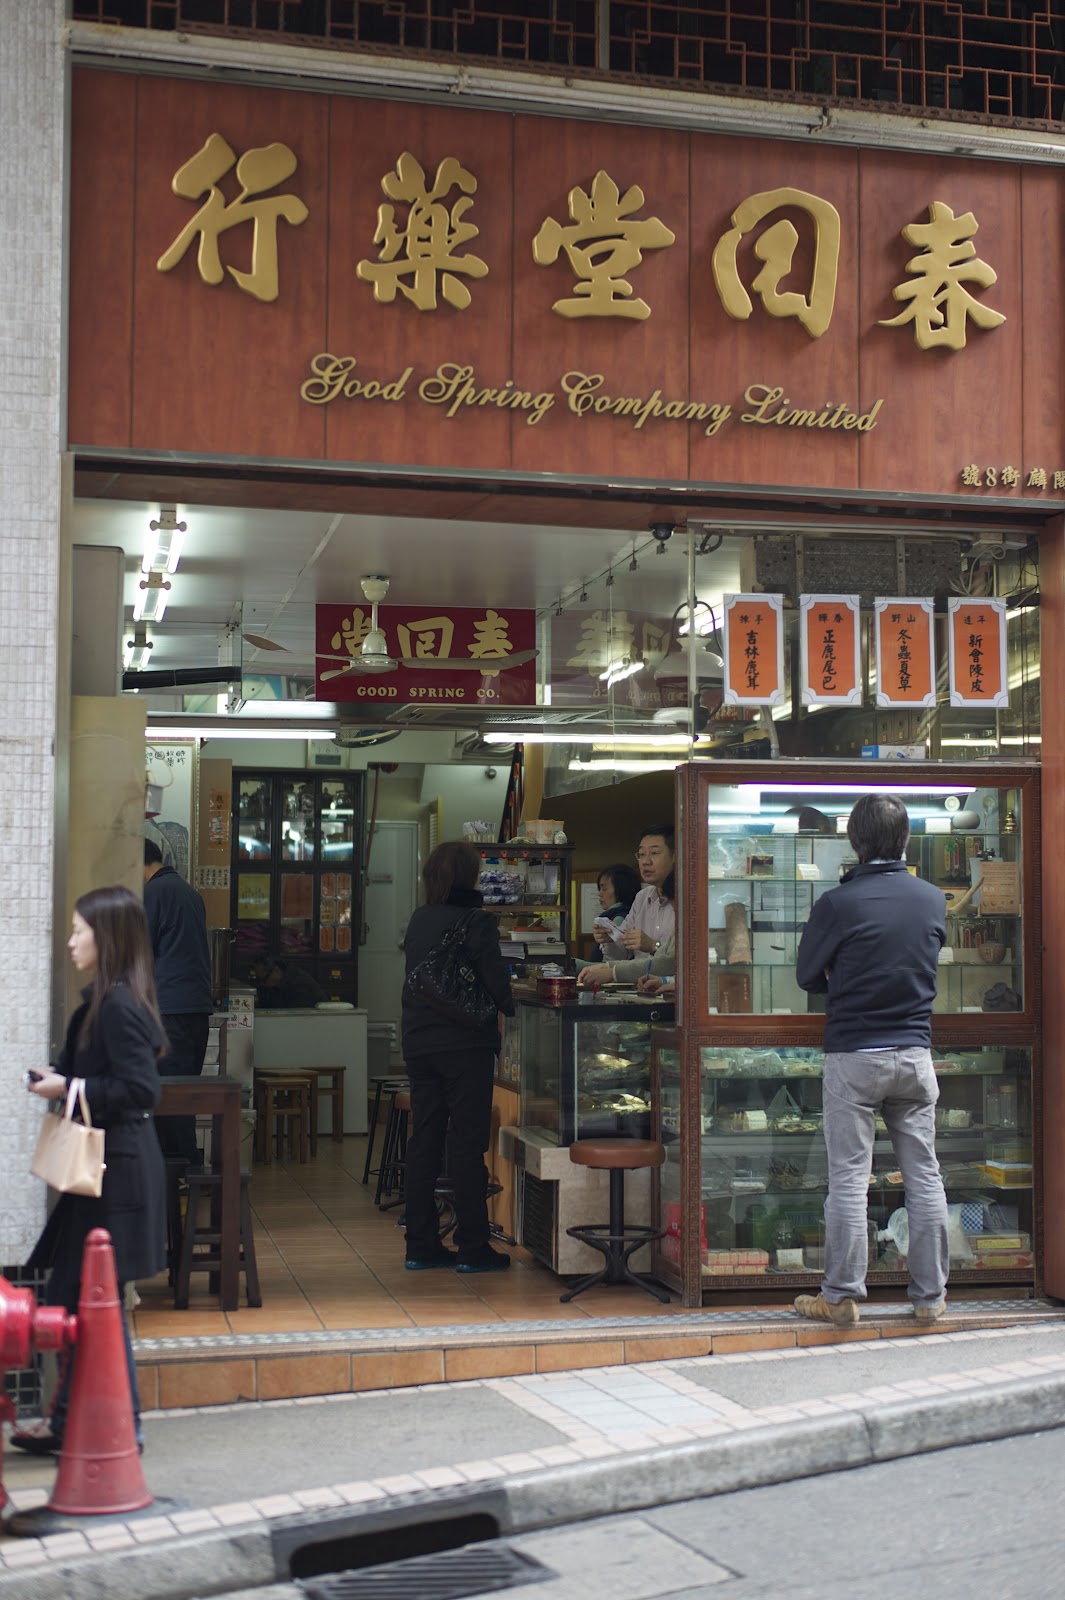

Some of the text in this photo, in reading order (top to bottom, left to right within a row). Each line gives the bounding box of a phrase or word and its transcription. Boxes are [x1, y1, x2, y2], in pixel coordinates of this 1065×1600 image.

[300, 353, 884, 437] Good Spring Company Limited
[744, 630, 760, 691] 吉林鹿茸
[821, 629, 837, 691] 正鹿尾巴
[896, 629, 912, 692] 冬蟲夏草
[968, 634, 985, 693] 新會陳皮
[357, 686, 500, 698] GOOD SPRING CO.
